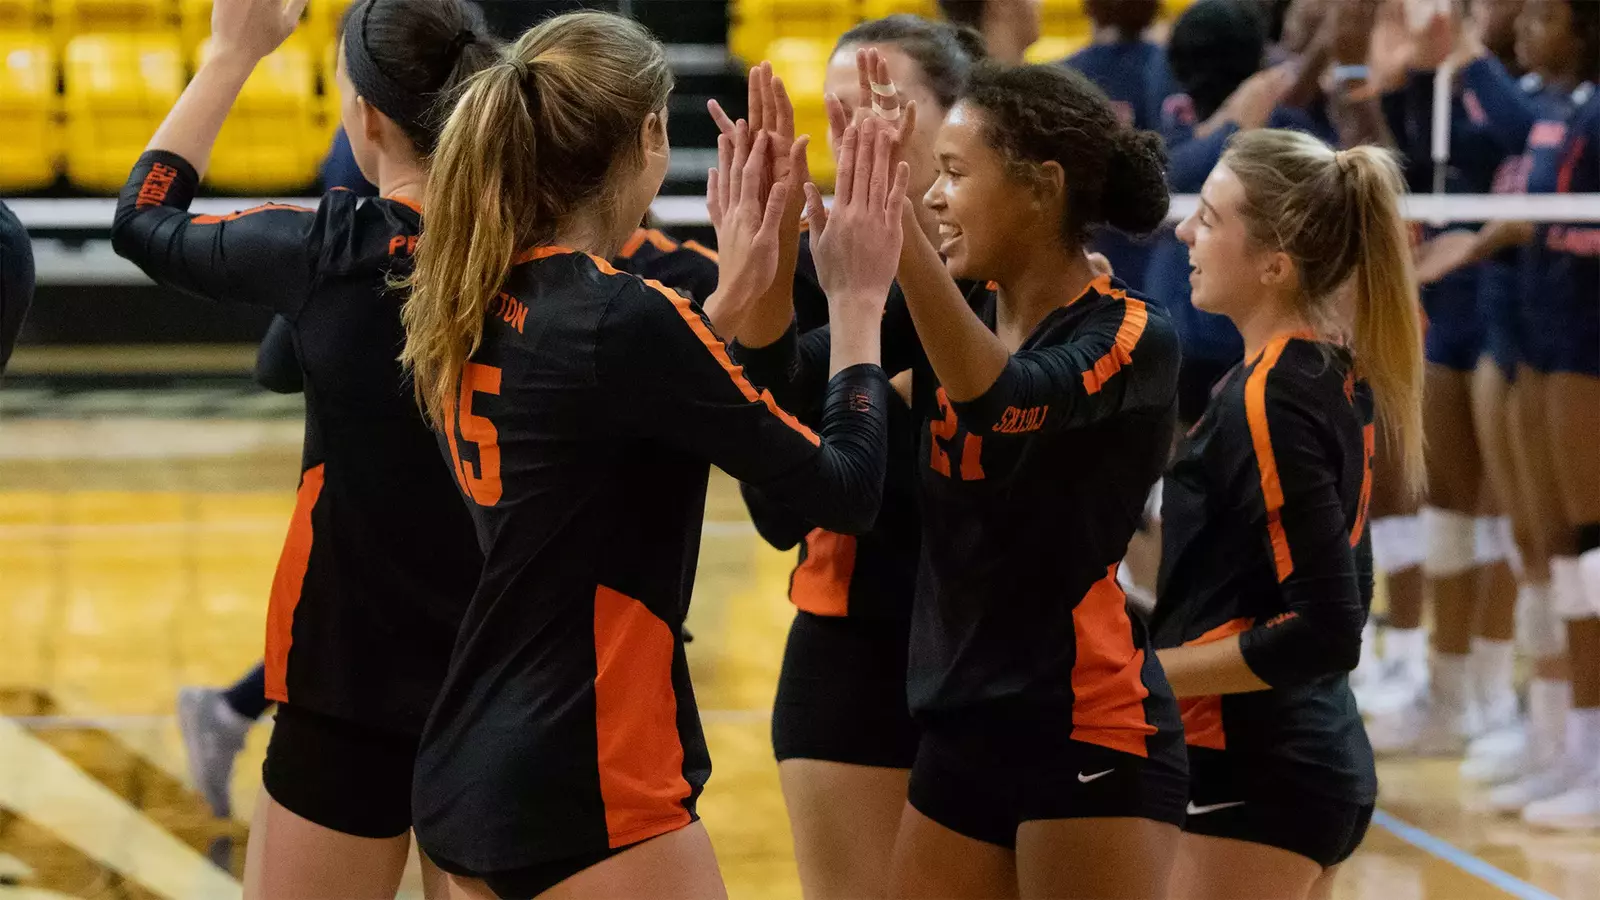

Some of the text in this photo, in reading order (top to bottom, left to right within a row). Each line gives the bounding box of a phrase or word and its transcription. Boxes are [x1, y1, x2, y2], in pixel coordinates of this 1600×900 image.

[135, 161, 178, 210] TIGERS
[442, 362, 503, 507] 15
[929, 386, 986, 481] 21
[991, 405, 1049, 433] TIGERS
